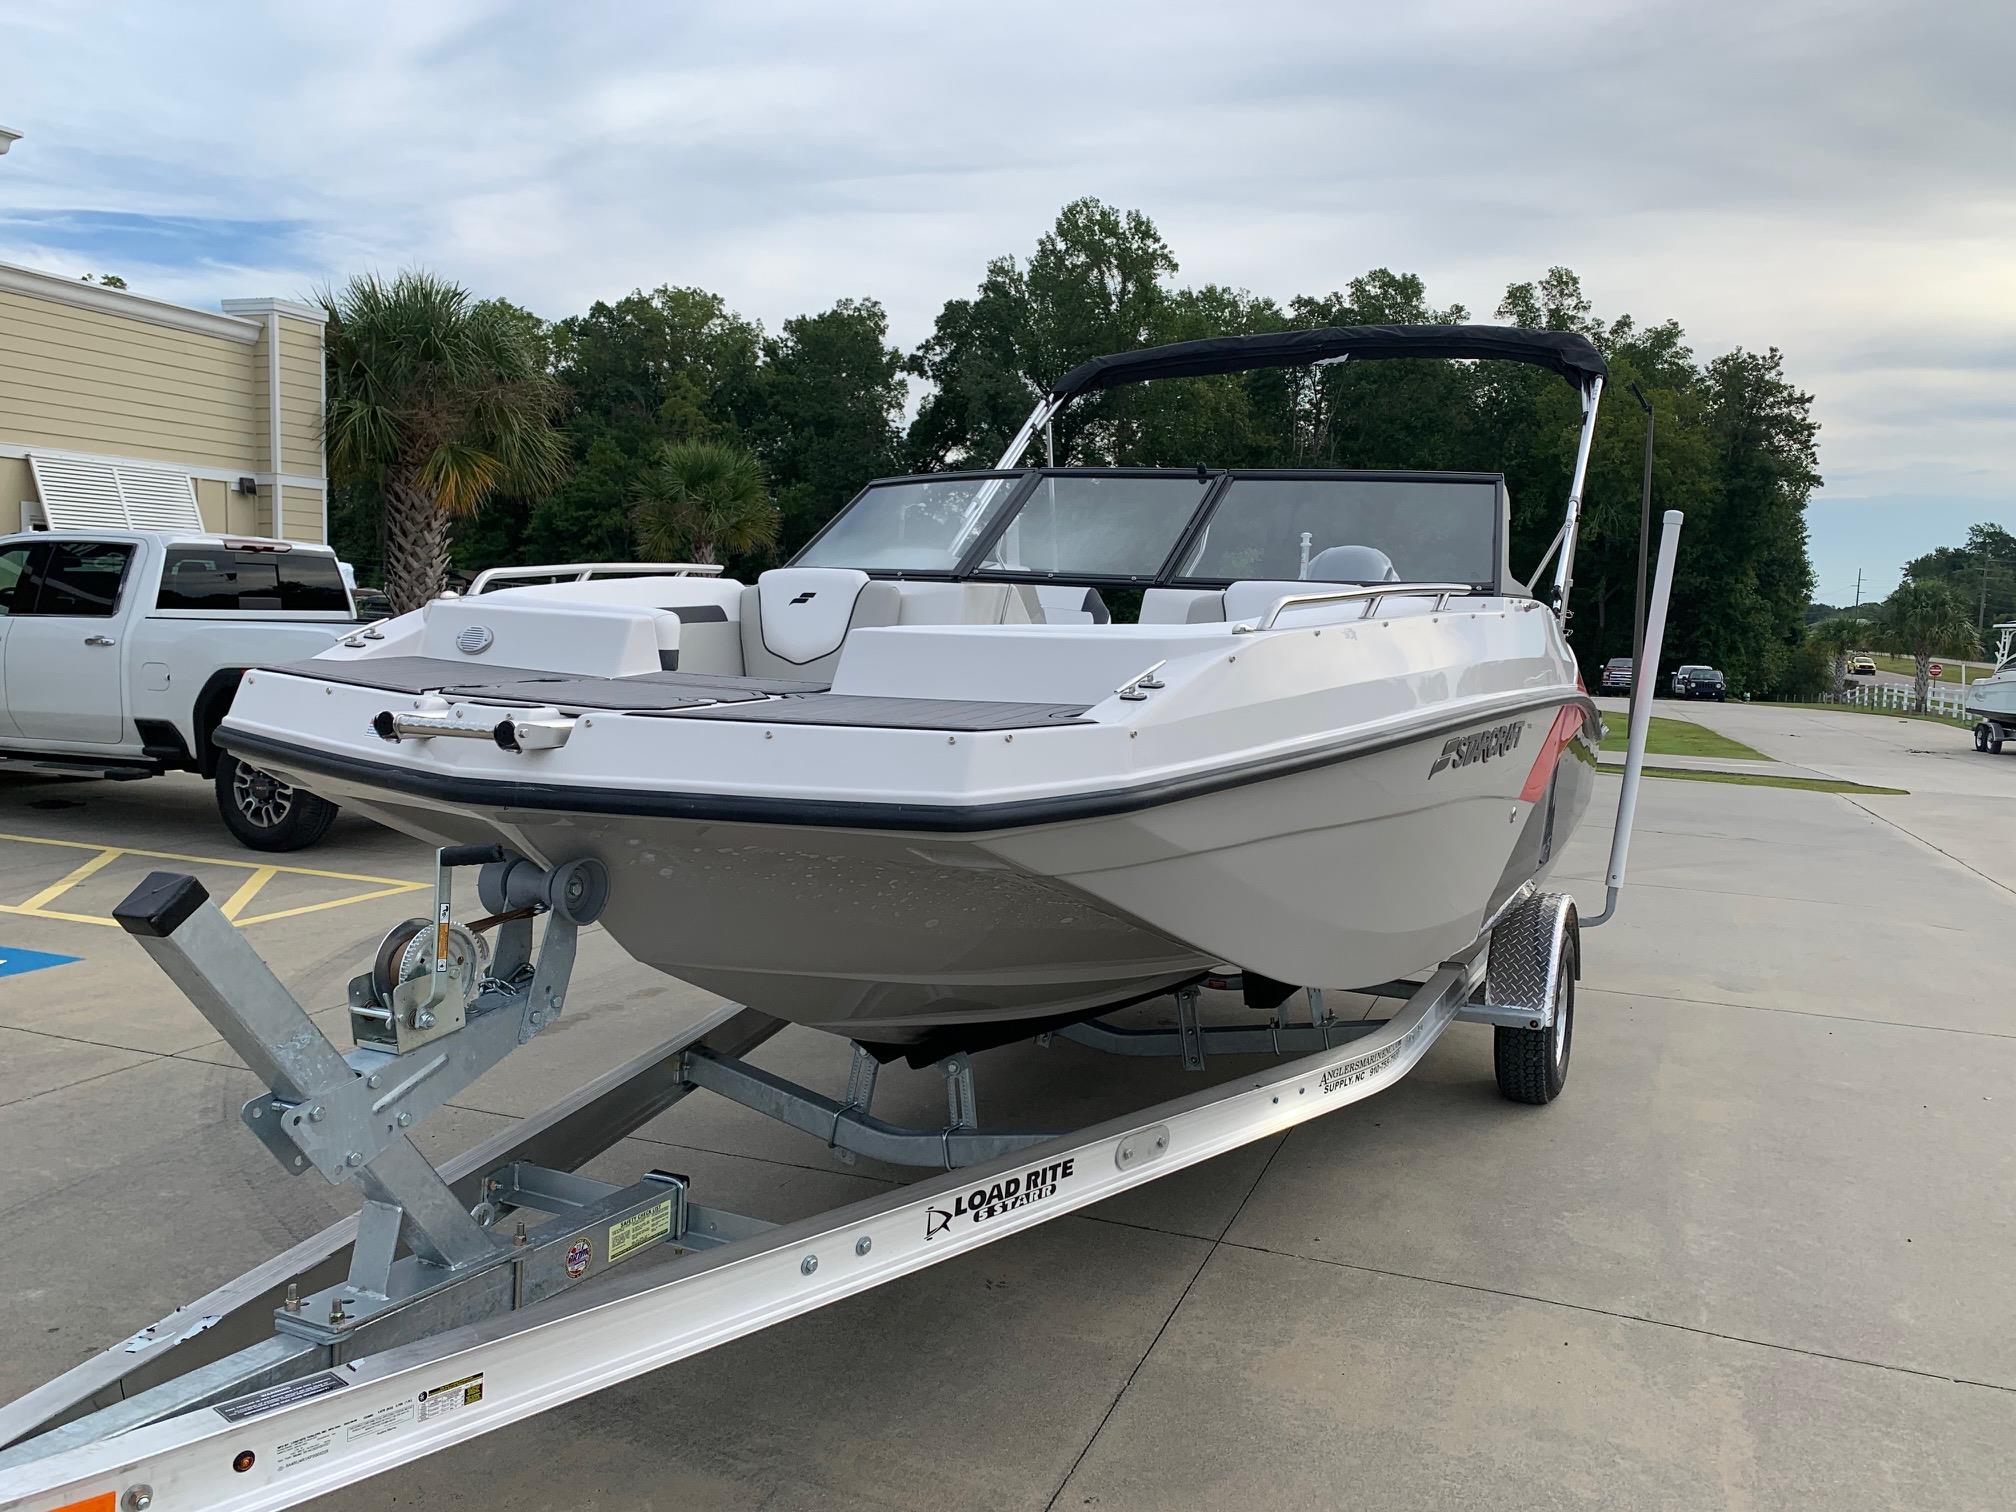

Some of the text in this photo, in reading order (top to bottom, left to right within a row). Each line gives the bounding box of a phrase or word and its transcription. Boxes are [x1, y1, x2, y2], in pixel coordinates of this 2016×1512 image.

[1452, 720, 1526, 769] STARCRAFT
[1355, 1071, 1365, 1084] NC
[954, 1158, 1074, 1216] LOAD RITE
[994, 1184, 1052, 1215] STARR
